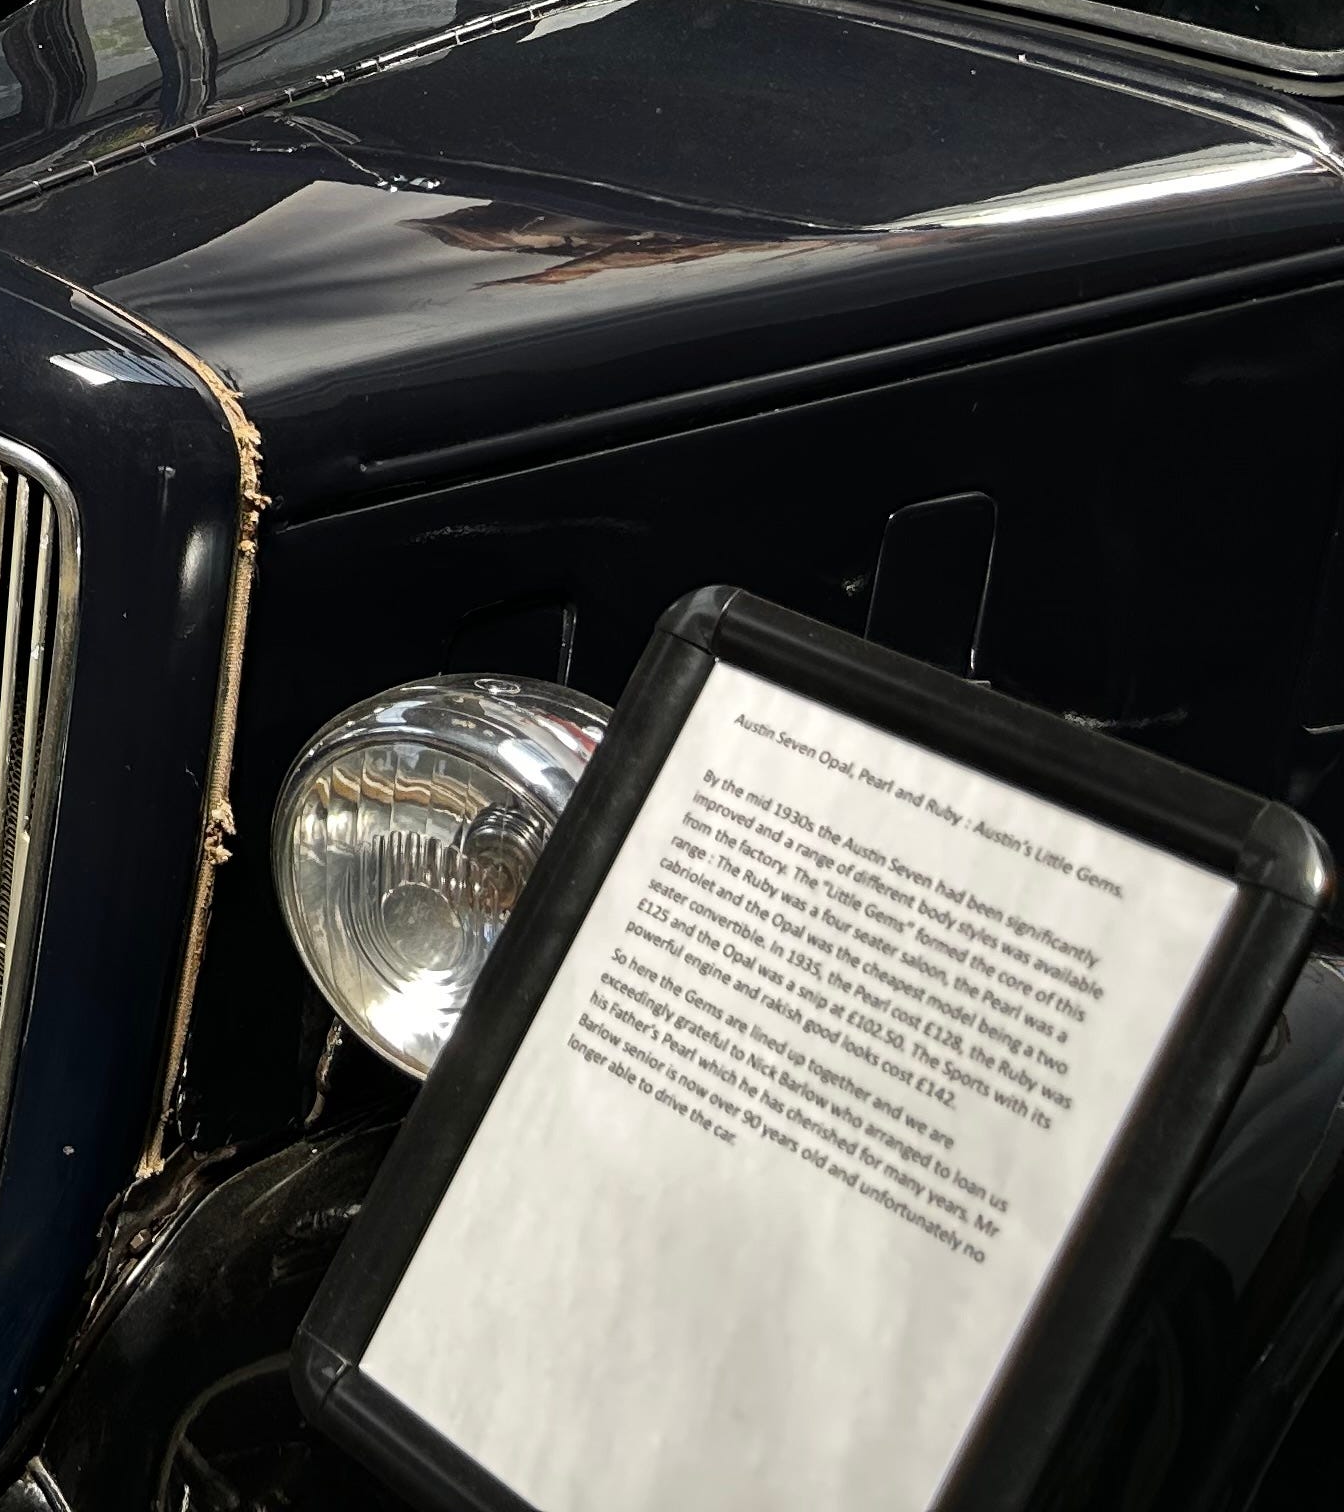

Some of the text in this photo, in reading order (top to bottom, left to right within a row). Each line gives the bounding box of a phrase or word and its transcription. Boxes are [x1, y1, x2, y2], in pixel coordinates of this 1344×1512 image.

[692, 790, 1104, 1000] improved and a range of different body styles was available
[702, 768, 1100, 970] By the mid 1930s the Austin Seven had been significantly
[733, 713, 776, 740] Austin
[775, 731, 817, 759] Seven
[817, 750, 855, 779] Opal,
[857, 767, 895, 793] Pearl
[893, 787, 926, 808] and
[924, 798, 963, 827] Ruby
[1033, 847, 1074, 875] Little
[1075, 866, 1123, 899] Gems.
[624, 920, 956, 1109] powerful engine and rakish good looks cost £142.
[636, 897, 1052, 1130] £125 and the Opal was a snip at £102.50. The Sports with its
[647, 878, 1073, 1110] seater convertible. In 1935, the Pearl cost £128, the Ruby was
[658, 856, 1069, 1076] cabriolet and the Opal was the cheapest model being a two
[670, 835, 707, 861] range
[716, 854, 741, 878] The
[741, 868, 780, 899] Ruby
[780, 890, 808, 912] was
[808, 905, 820, 919] a
[820, 908, 853, 934] four
[851, 927, 900, 957] seater
[898, 951, 949, 987] saloon,
[952, 976, 980, 999] the
[980, 989, 1023, 1020] Pearl
[1023, 1013, 1055, 1037] was
[1055, 1031, 1069, 1044] a
[681, 810, 713, 836] from
[714, 828, 738, 849] the
[737, 838, 788, 876] factory.
[793, 865, 819, 890] The
[914, 926, 970, 964] formed
[969, 954, 997, 978] the
[997, 971, 1034, 996] core
[1034, 989, 1057, 1006] of
[1054, 996, 1086, 1023] this
